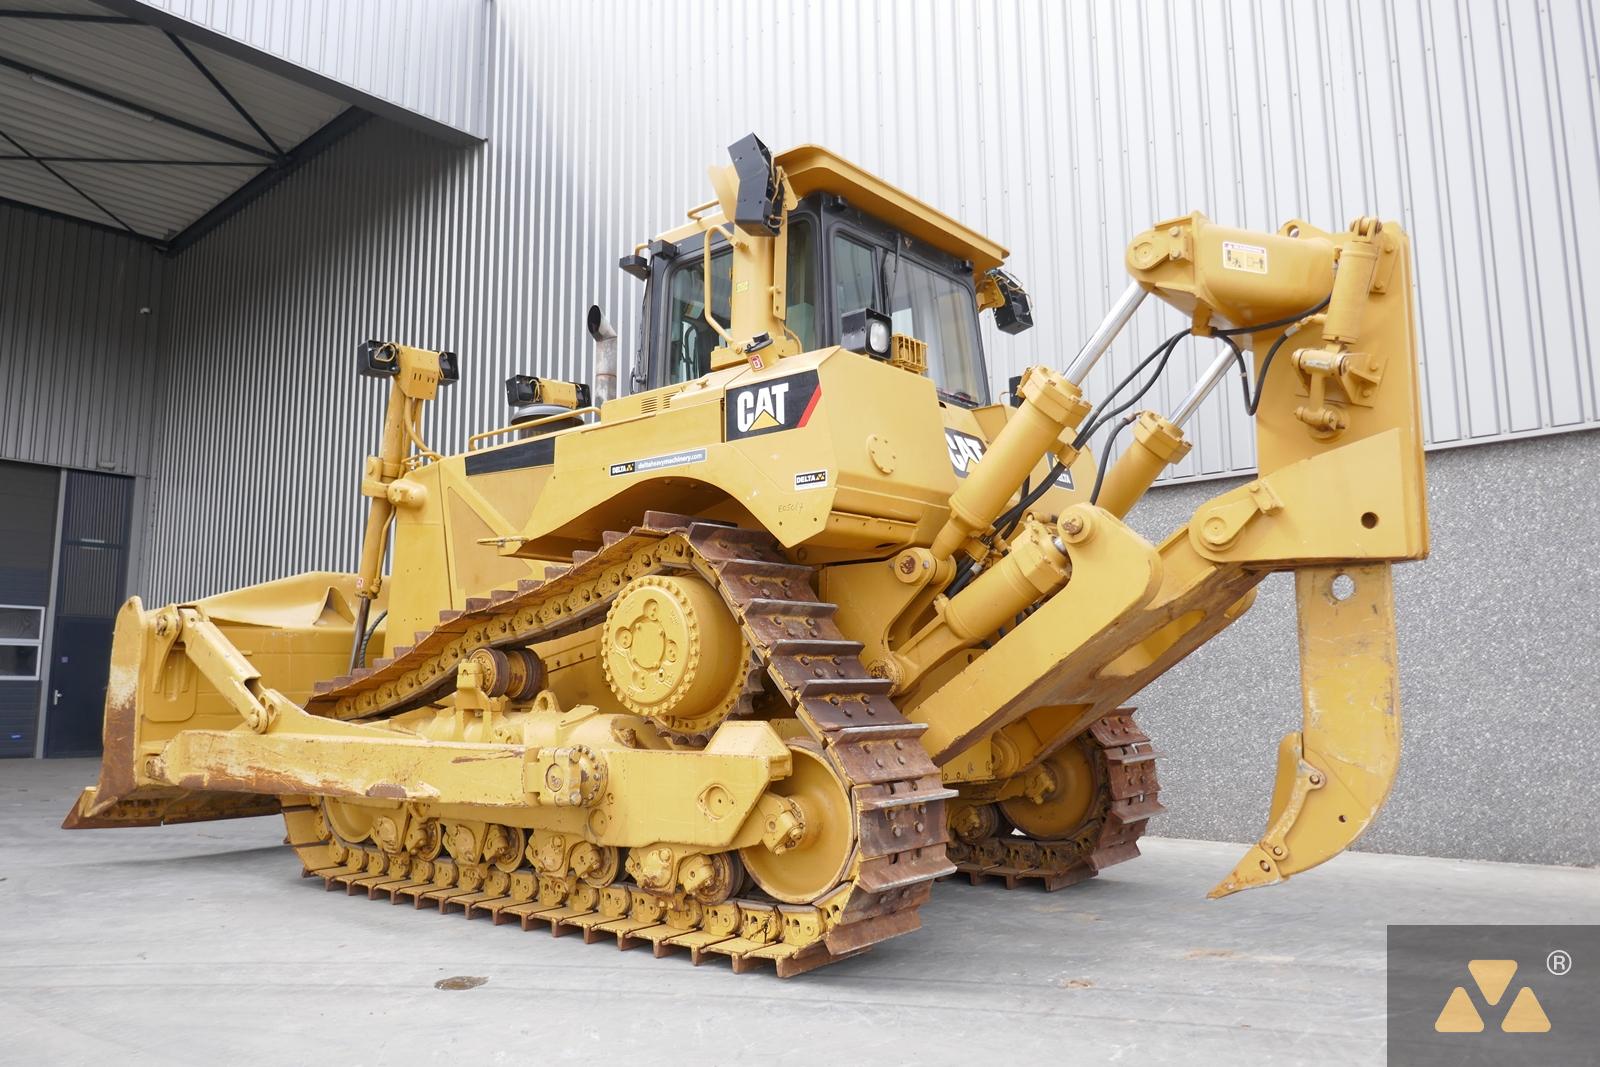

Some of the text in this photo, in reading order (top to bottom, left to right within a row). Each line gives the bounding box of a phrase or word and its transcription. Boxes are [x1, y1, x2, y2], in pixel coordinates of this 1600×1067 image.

[737, 382, 789, 432] CAT
[612, 465, 627, 474] DELTA
[796, 474, 816, 484] DELTA
